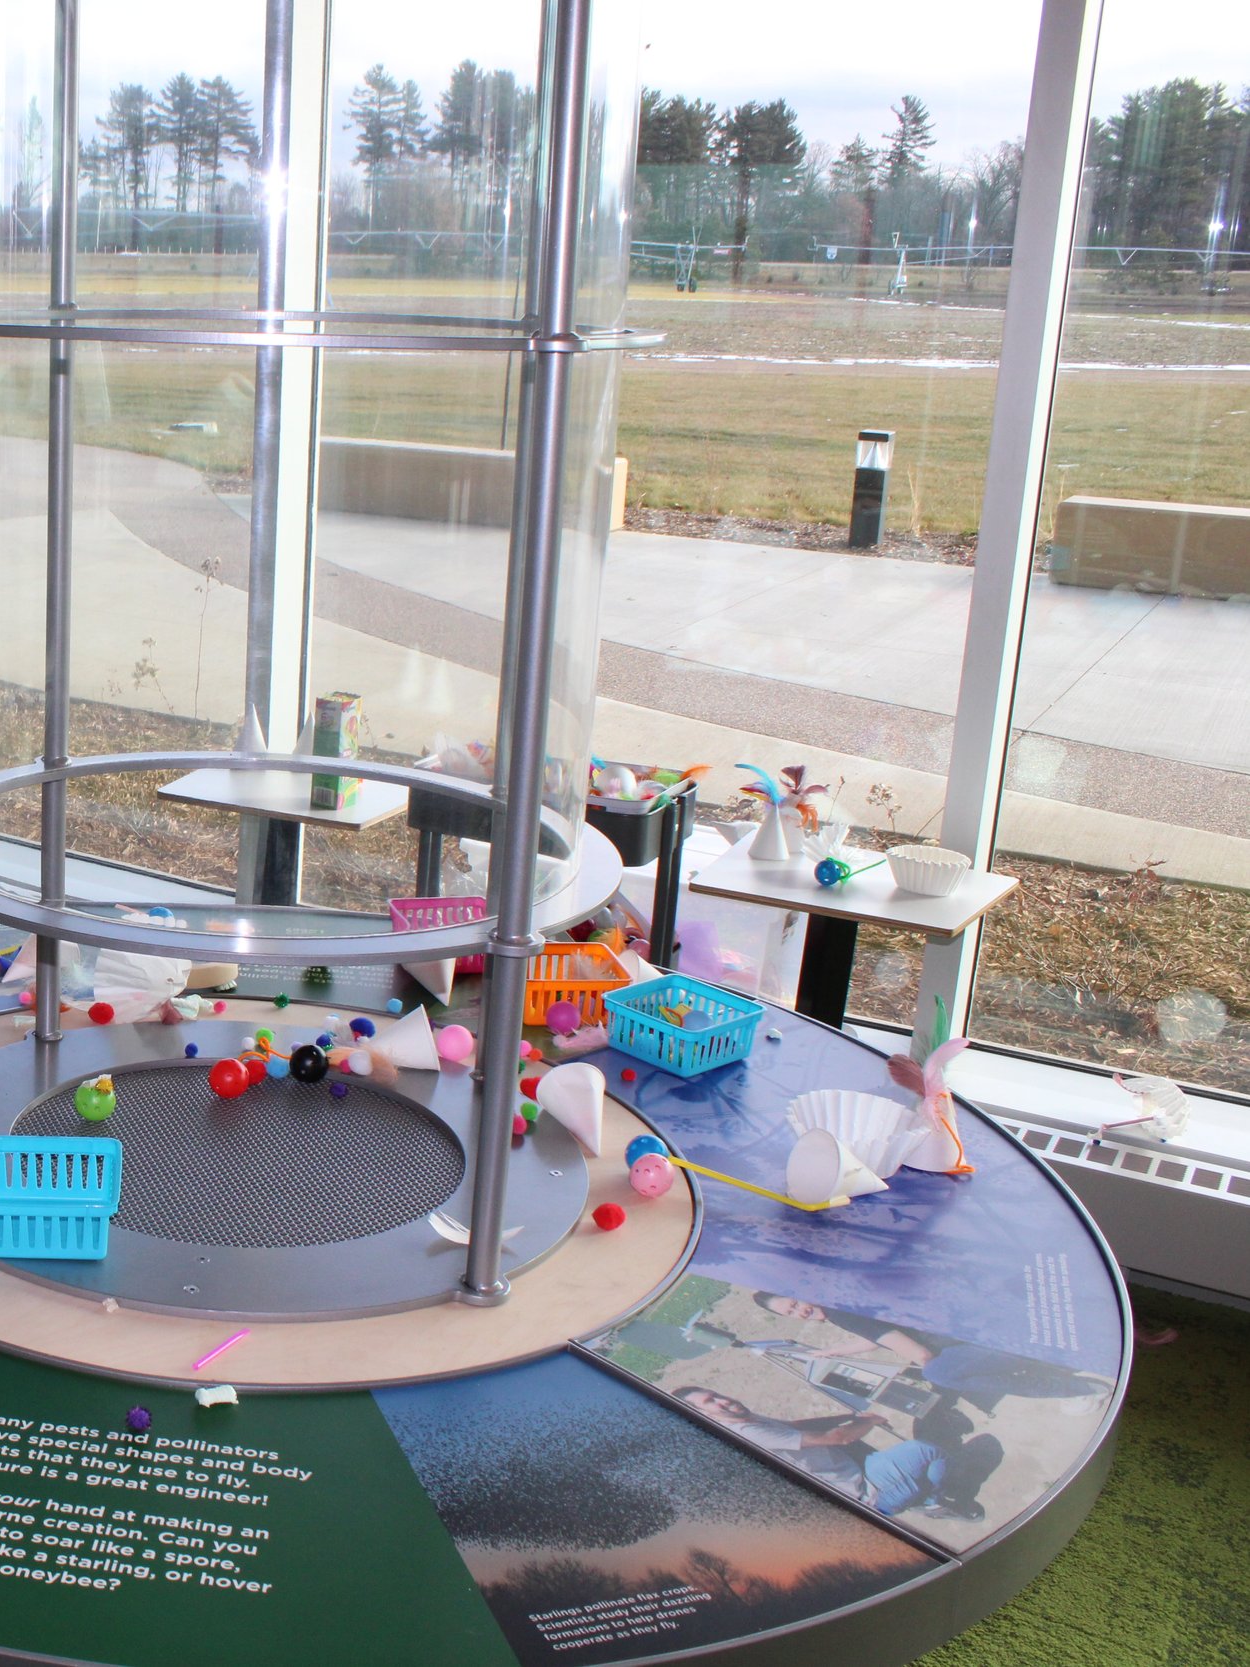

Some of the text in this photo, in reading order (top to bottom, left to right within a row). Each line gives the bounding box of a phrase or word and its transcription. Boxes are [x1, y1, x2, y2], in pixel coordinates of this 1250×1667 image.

[28, 1437, 108, 1454] special
[115, 1447, 195, 1465] shapes
[202, 1458, 245, 1472] and
[253, 1463, 313, 1481] body
[40, 1422, 99, 1438] pests
[107, 1431, 149, 1444] and
[156, 1438, 279, 1460] pollinators
[28, 1449, 74, 1465] that
[81, 1457, 131, 1474] they
[139, 1465, 178, 1479] use
[186, 1470, 210, 1482] to
[218, 1473, 251, 1489] fly.
[40, 1466, 59, 1479] is
[65, 1471, 79, 1482] a
[86, 1475, 149, 1491] great
[156, 1484, 269, 1507] engineer!
[43, 1518, 148, 1542] creation.
[158, 1532, 205, 1549] Can
[213, 1541, 258, 1556] you
[46, 1498, 106, 1518] hand
[112, 1510, 137, 1522] at
[143, 1514, 233, 1537] making
[241, 1527, 270, 1540] an
[0, 1527, 24, 1541] to
[31, 1534, 85, 1549] soar
[91, 1539, 135, 1556] like
[142, 1549, 157, 1560] a
[164, 1553, 241, 1574] spore,
[34, 1551, 48, 1563] a
[55, 1555, 156, 1581] starling,
[165, 1570, 193, 1583] or
[200, 1572, 273, 1594] hover
[528, 1585, 698, 1623] Starlings pollinate flax crops.
[536, 1593, 712, 1632] Scientists study their dazzling
[543, 1607, 697, 1642] formations to help drones
[552, 1621, 680, 1651] cooperate as they fly.
